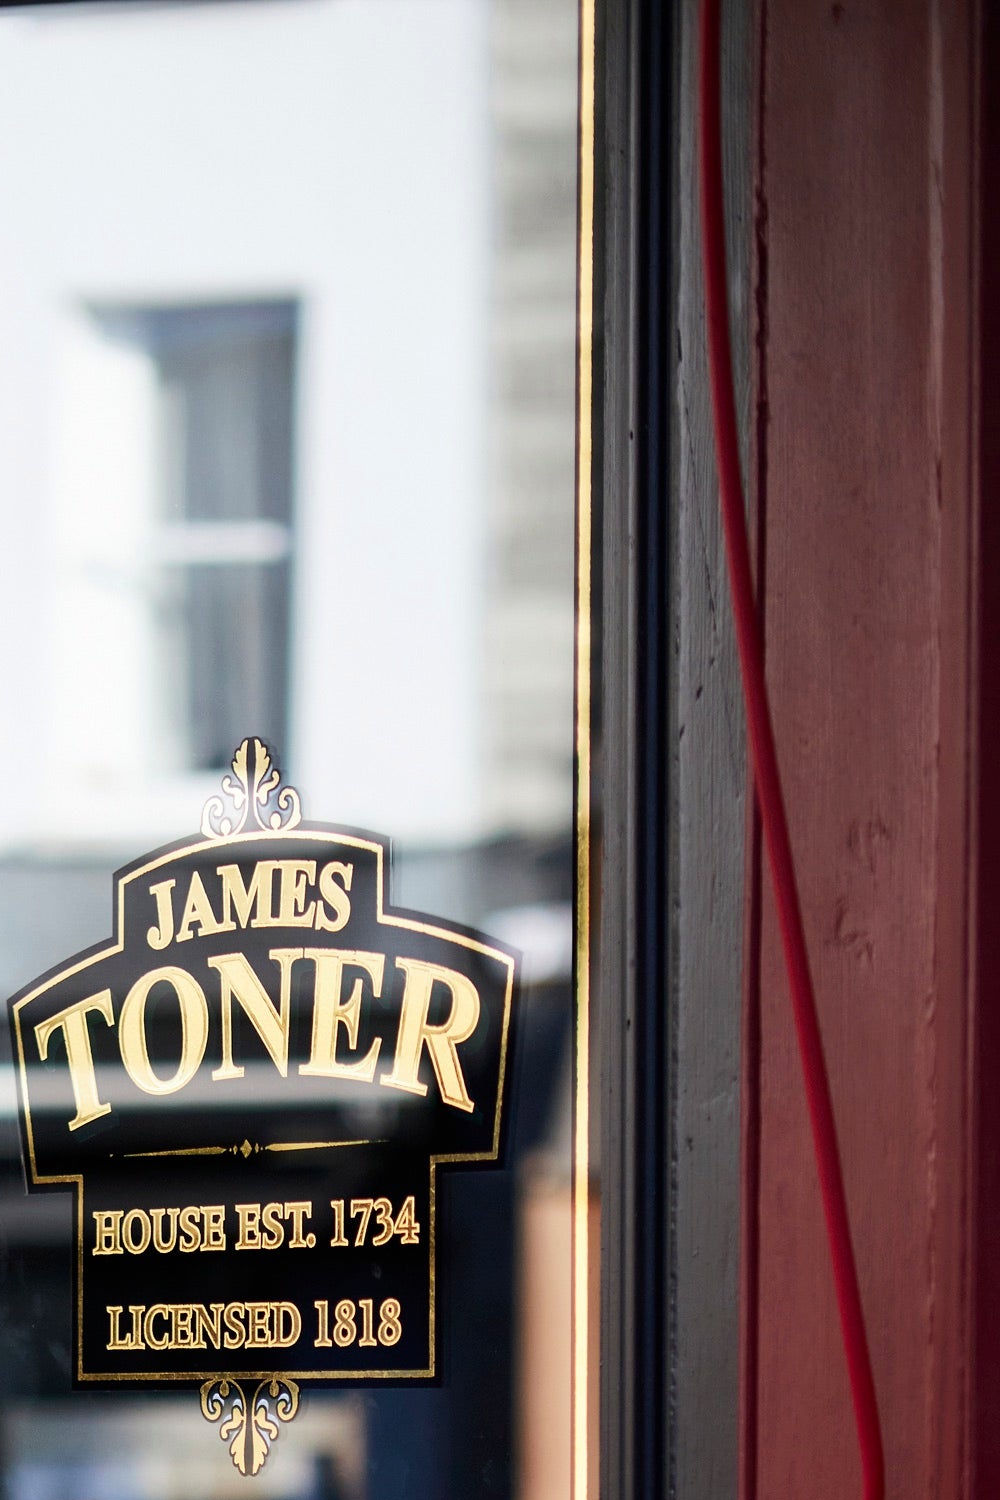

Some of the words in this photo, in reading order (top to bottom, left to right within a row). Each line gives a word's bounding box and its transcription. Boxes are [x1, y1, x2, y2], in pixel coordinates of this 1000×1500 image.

[147, 859, 353, 950] JAMES
[34, 948, 482, 1132] TONER
[93, 1204, 226, 1256] HOUSE
[234, 1202, 316, 1249] EST.
[330, 1197, 420, 1246] 1734
[106, 1302, 302, 1350] LICENSED
[313, 1299, 402, 1348] 1818
